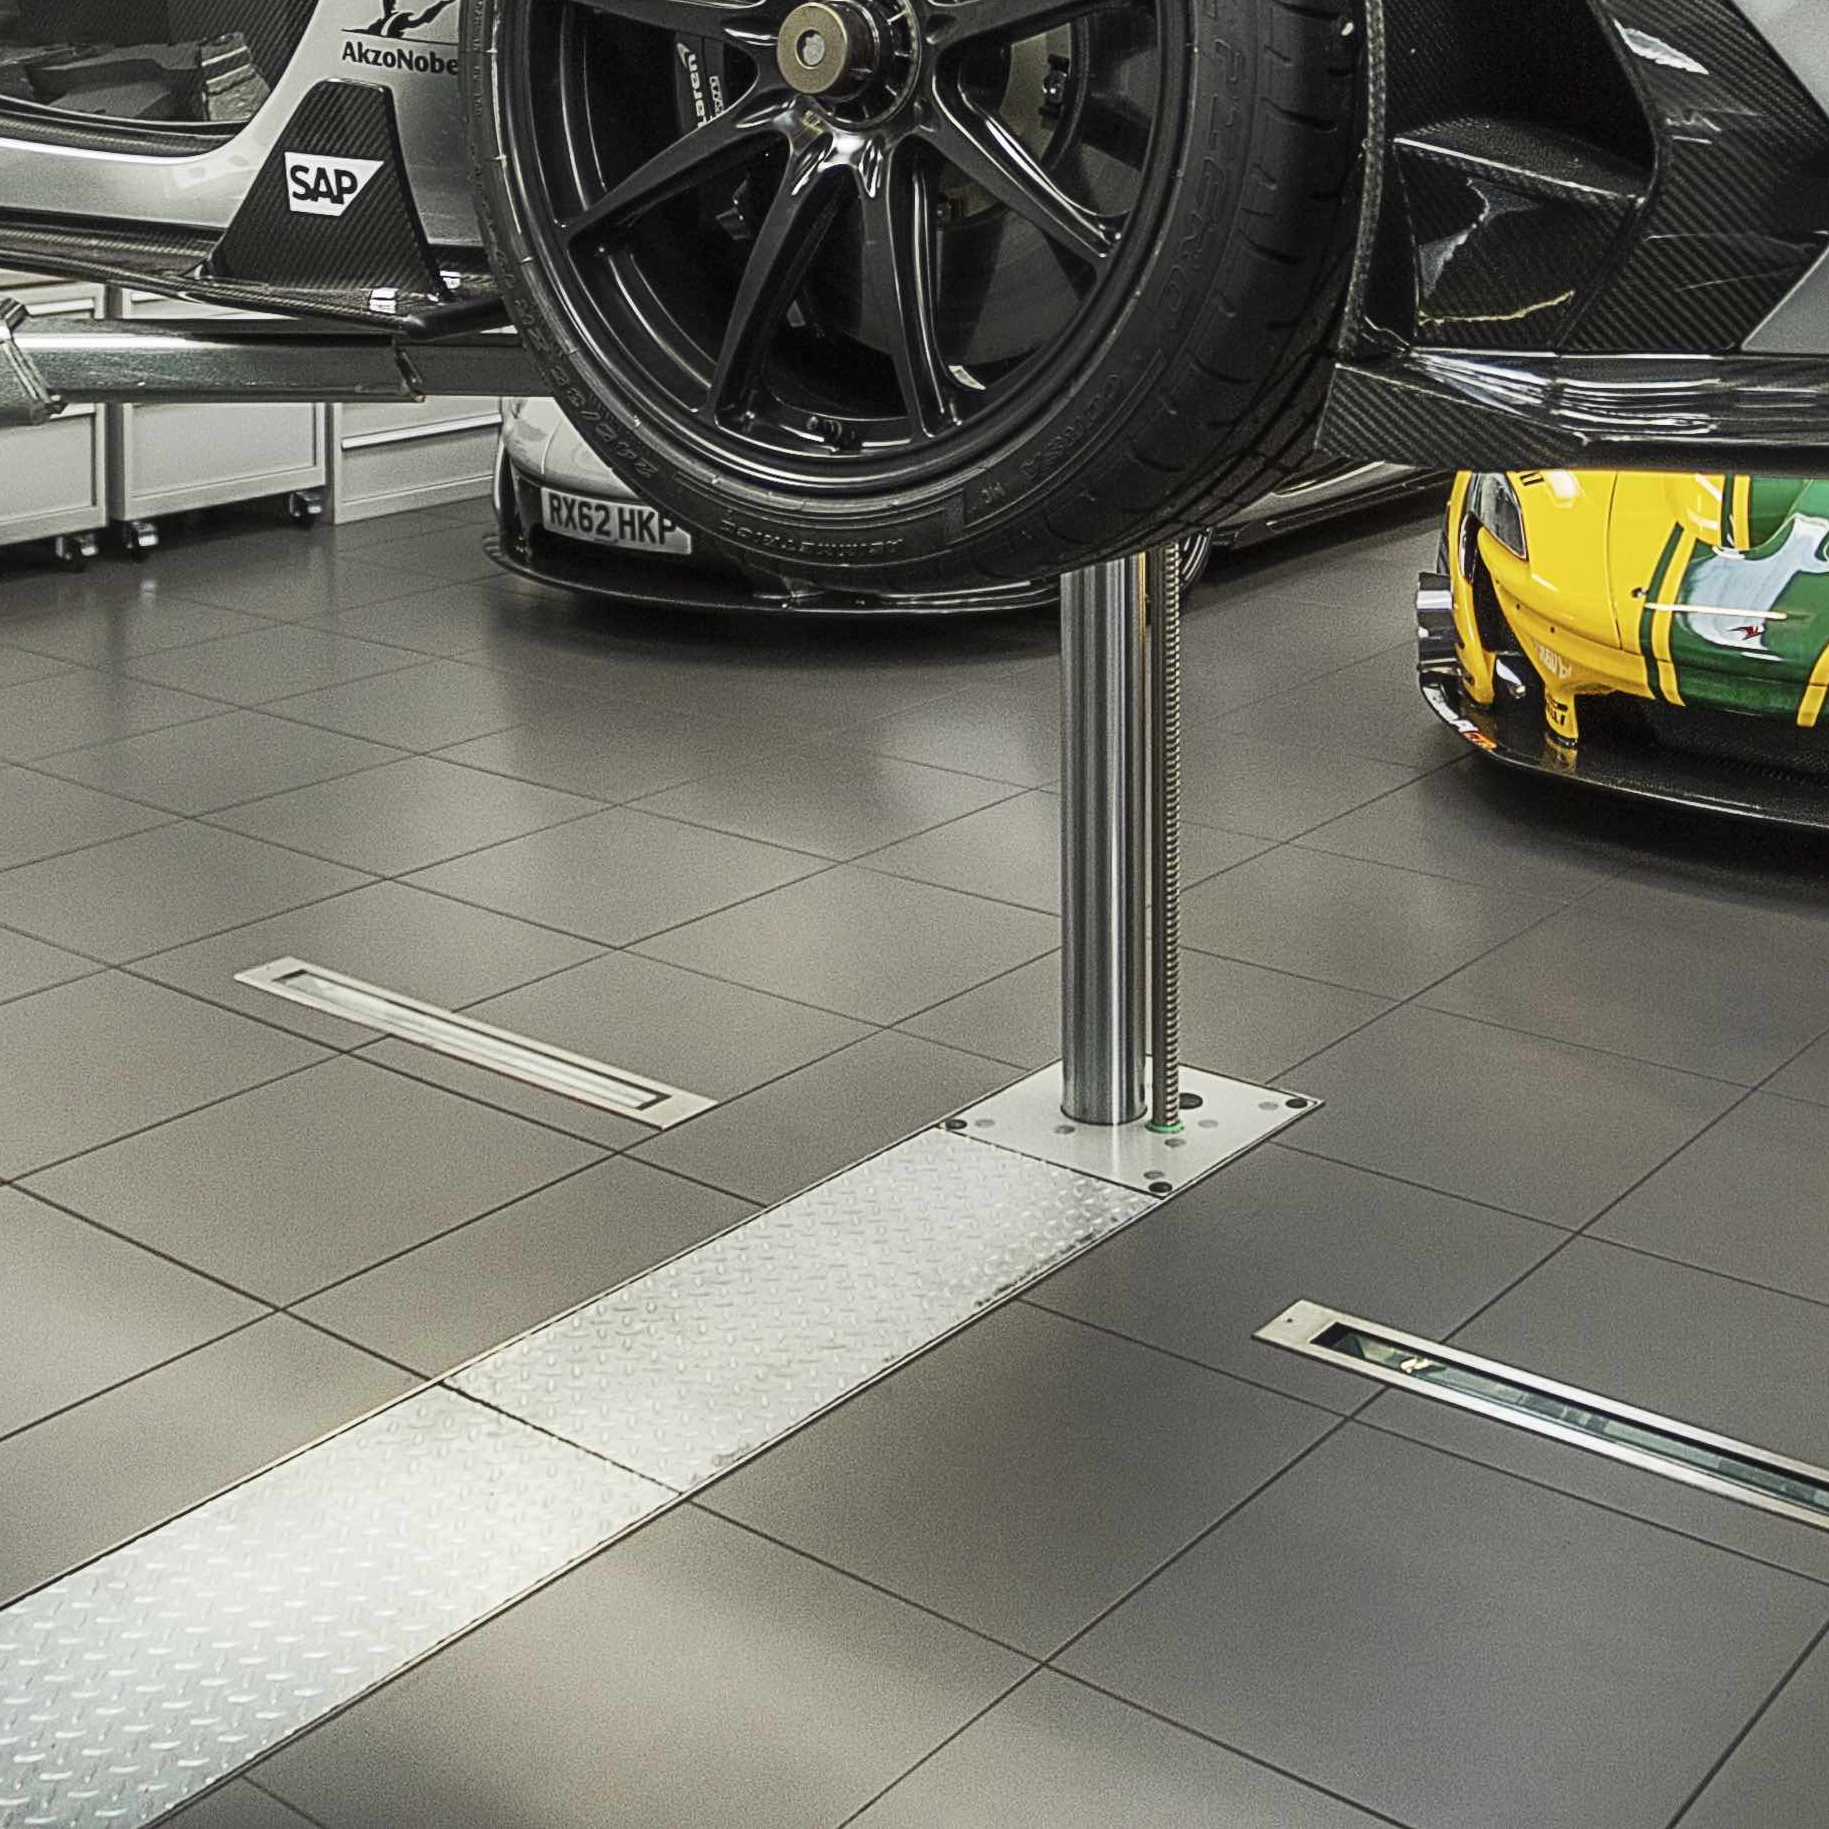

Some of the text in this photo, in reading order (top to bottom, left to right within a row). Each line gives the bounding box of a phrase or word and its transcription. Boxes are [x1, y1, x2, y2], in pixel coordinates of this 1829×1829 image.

[341, 39, 460, 76] AkzoNobe
[290, 164, 359, 206] SAP
[549, 492, 611, 538] RX62
[617, 507, 677, 545] HKP
